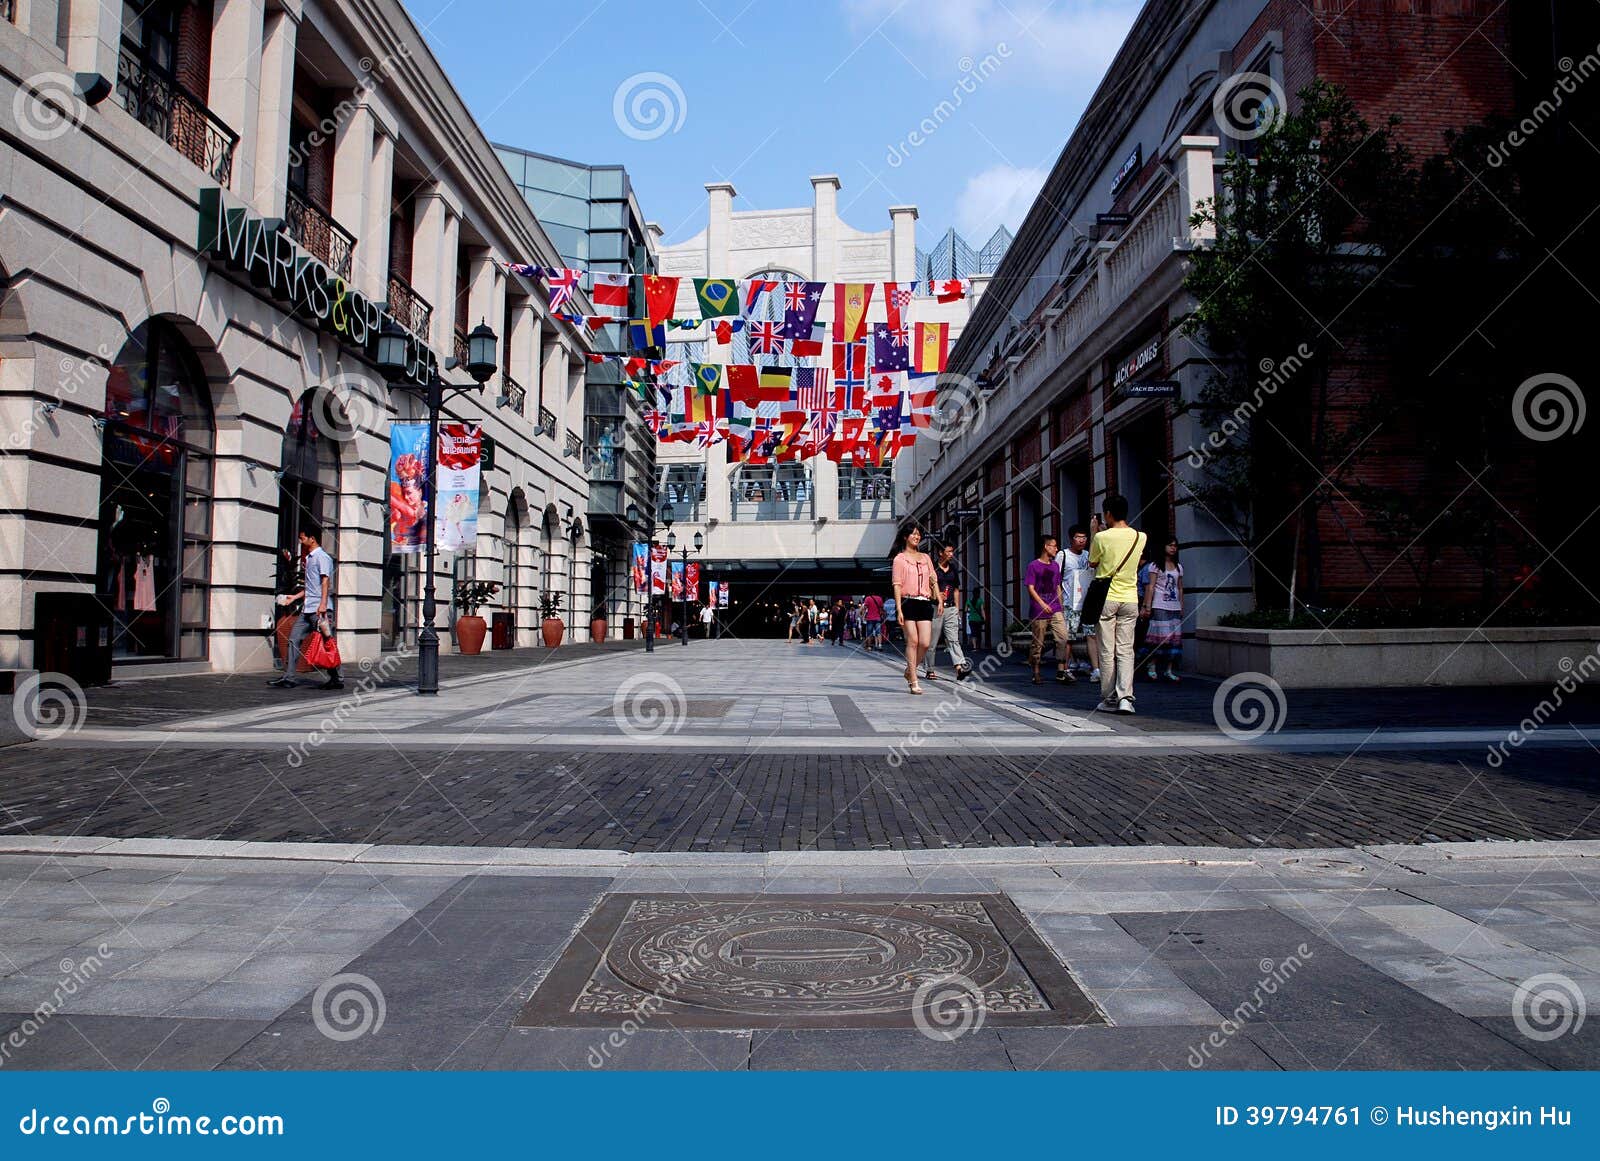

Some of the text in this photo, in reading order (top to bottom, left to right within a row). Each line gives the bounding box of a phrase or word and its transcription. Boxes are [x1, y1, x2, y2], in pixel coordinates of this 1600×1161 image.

[216, 187, 330, 319] MARKS
[331, 277, 349, 335] &
[1113, 363, 1129, 388] JACK
[1135, 341, 1158, 372] JONES
